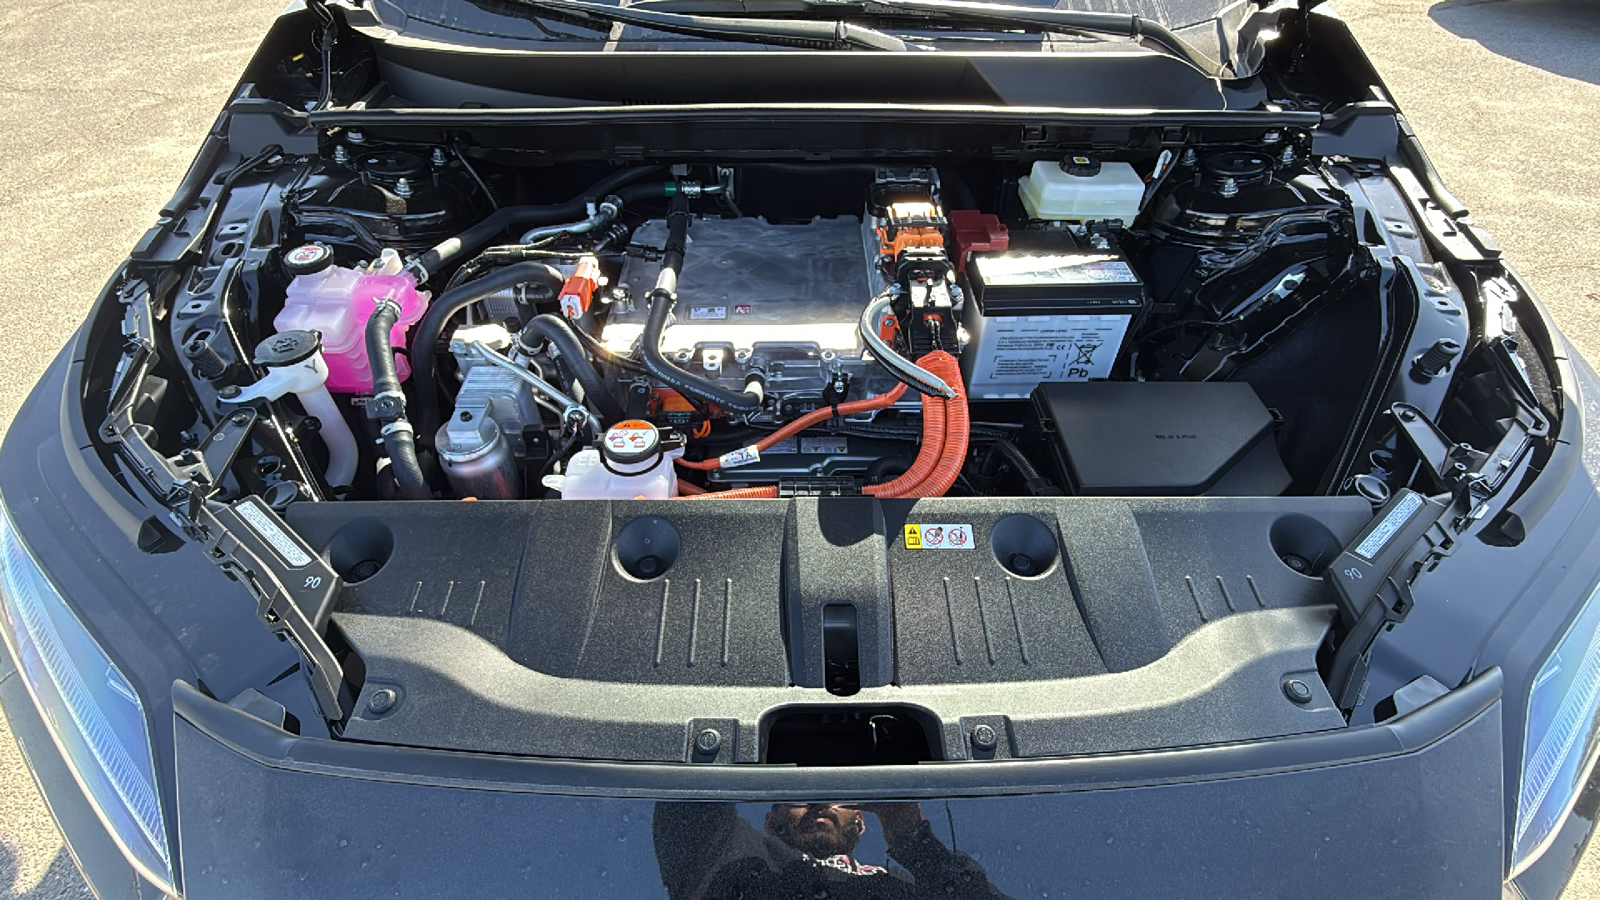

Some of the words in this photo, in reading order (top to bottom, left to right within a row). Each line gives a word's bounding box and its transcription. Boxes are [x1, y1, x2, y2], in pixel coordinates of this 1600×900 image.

[1067, 368, 1089, 378] Pb
[1344, 567, 1363, 580] 90
[303, 576, 322, 589] 90
